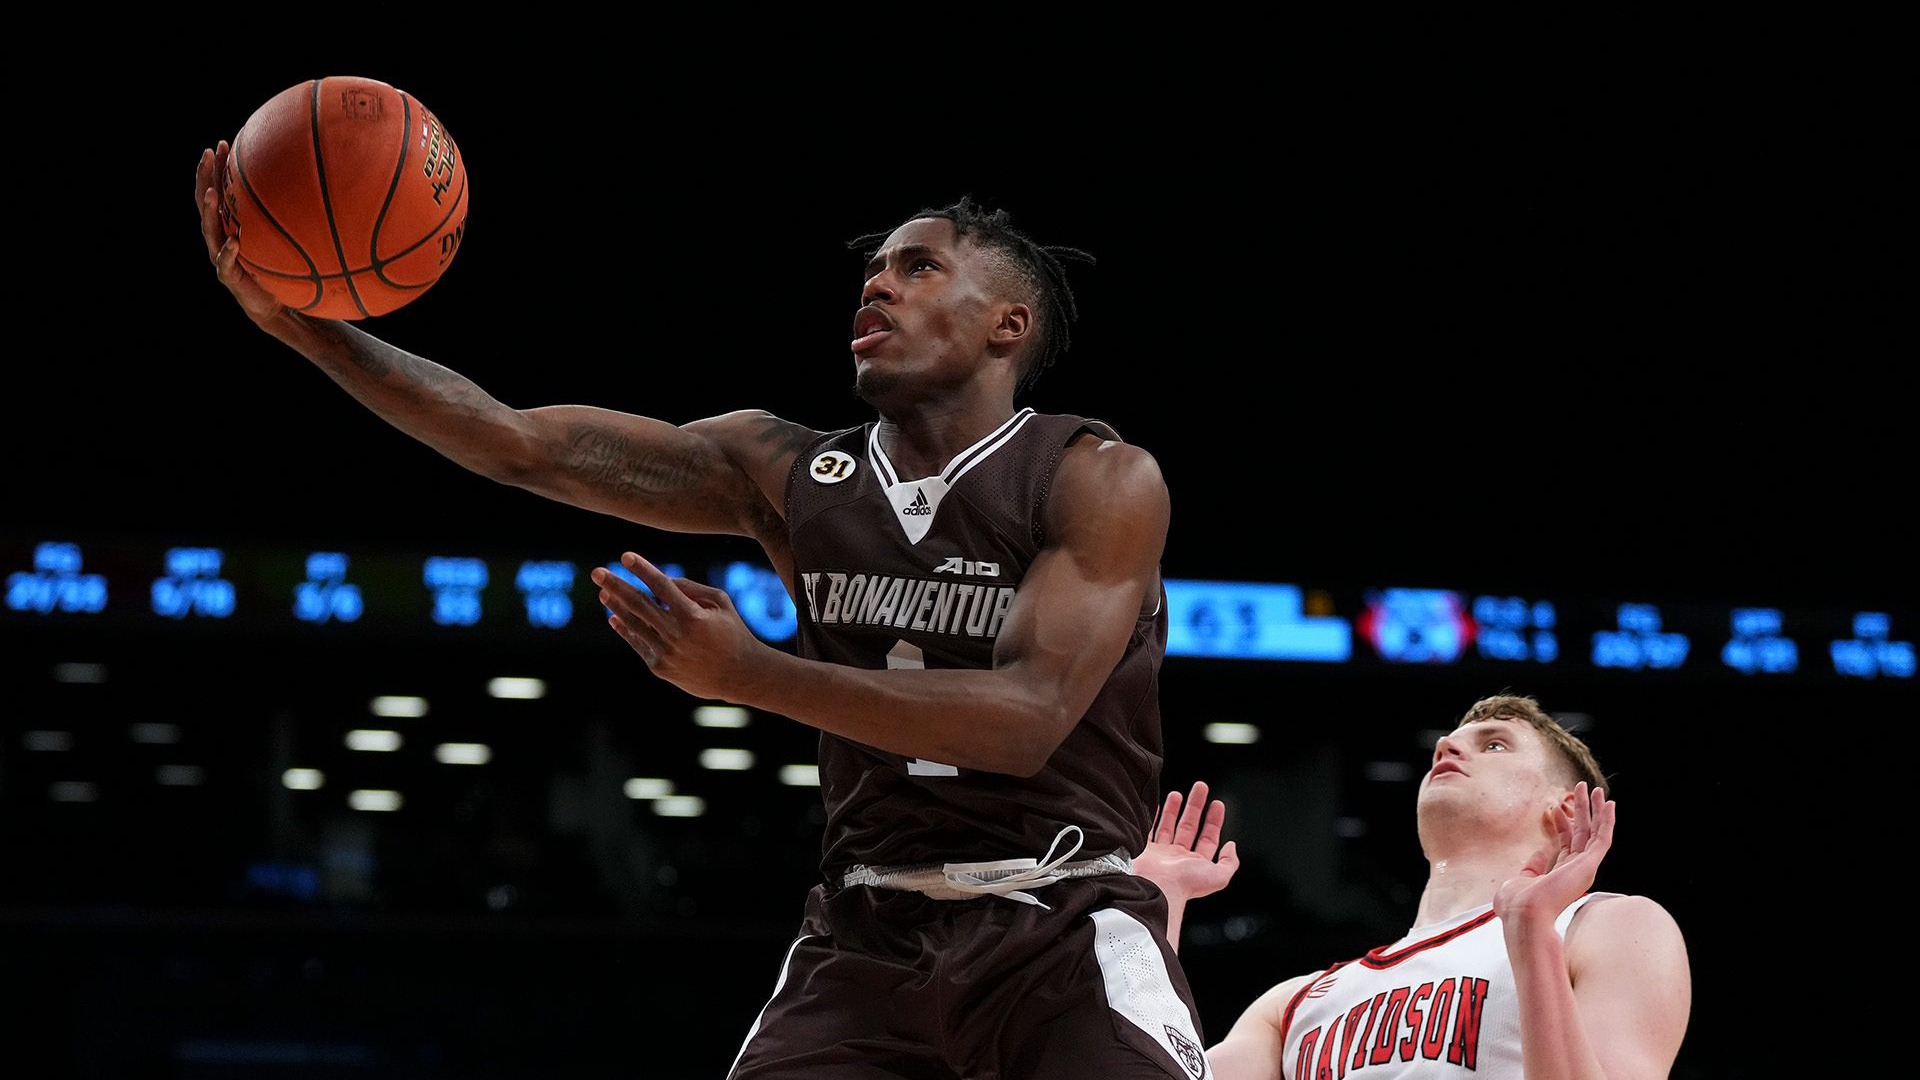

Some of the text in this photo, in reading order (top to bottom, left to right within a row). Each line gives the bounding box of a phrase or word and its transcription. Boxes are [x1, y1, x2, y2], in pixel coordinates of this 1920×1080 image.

[815, 456, 849, 478] 31
[902, 505, 932, 516] adidas
[801, 572, 822, 623] ST
[1295, 975, 1489, 1080] DAVIDSON
